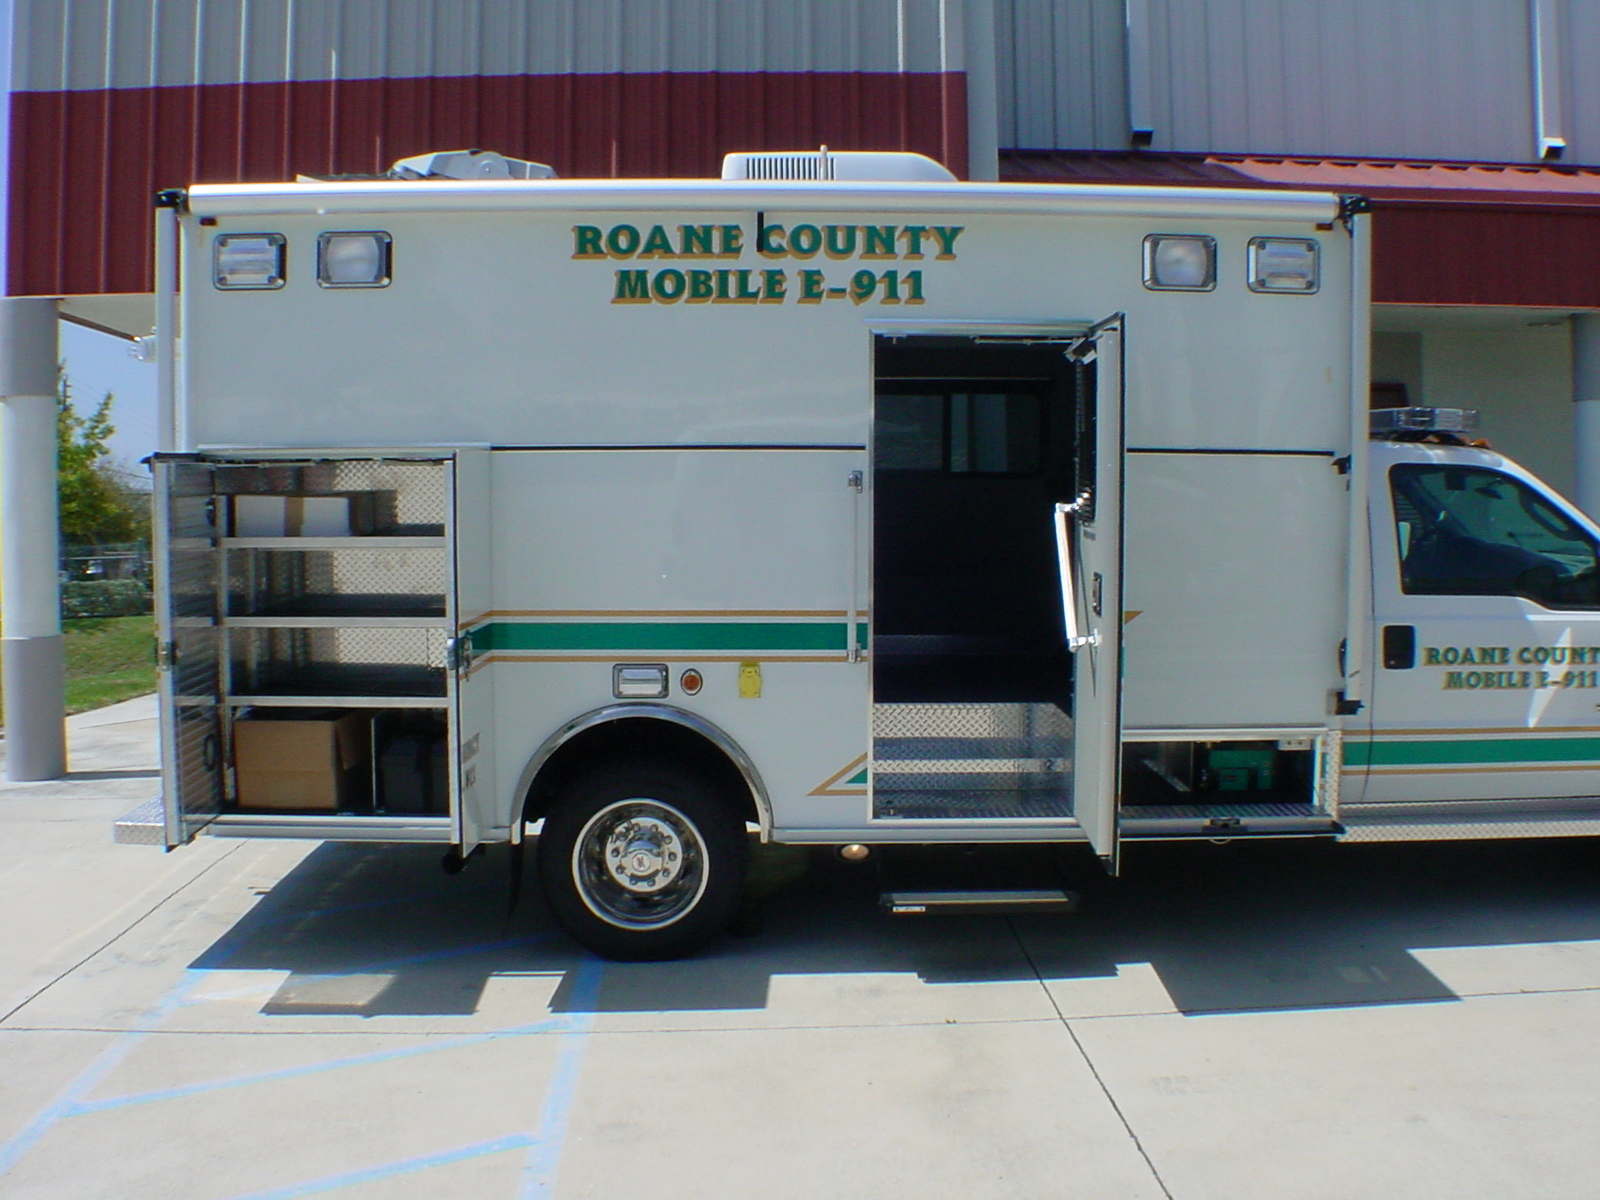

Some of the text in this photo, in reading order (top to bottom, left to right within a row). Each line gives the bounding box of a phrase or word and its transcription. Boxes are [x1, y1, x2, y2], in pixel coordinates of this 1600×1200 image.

[571, 224, 965, 261] ROANE COUNTY
[610, 269, 926, 306] MOBILE E-911
[1423, 647, 1510, 666] ROANE
[1441, 670, 1599, 690] MOBILE E-911
